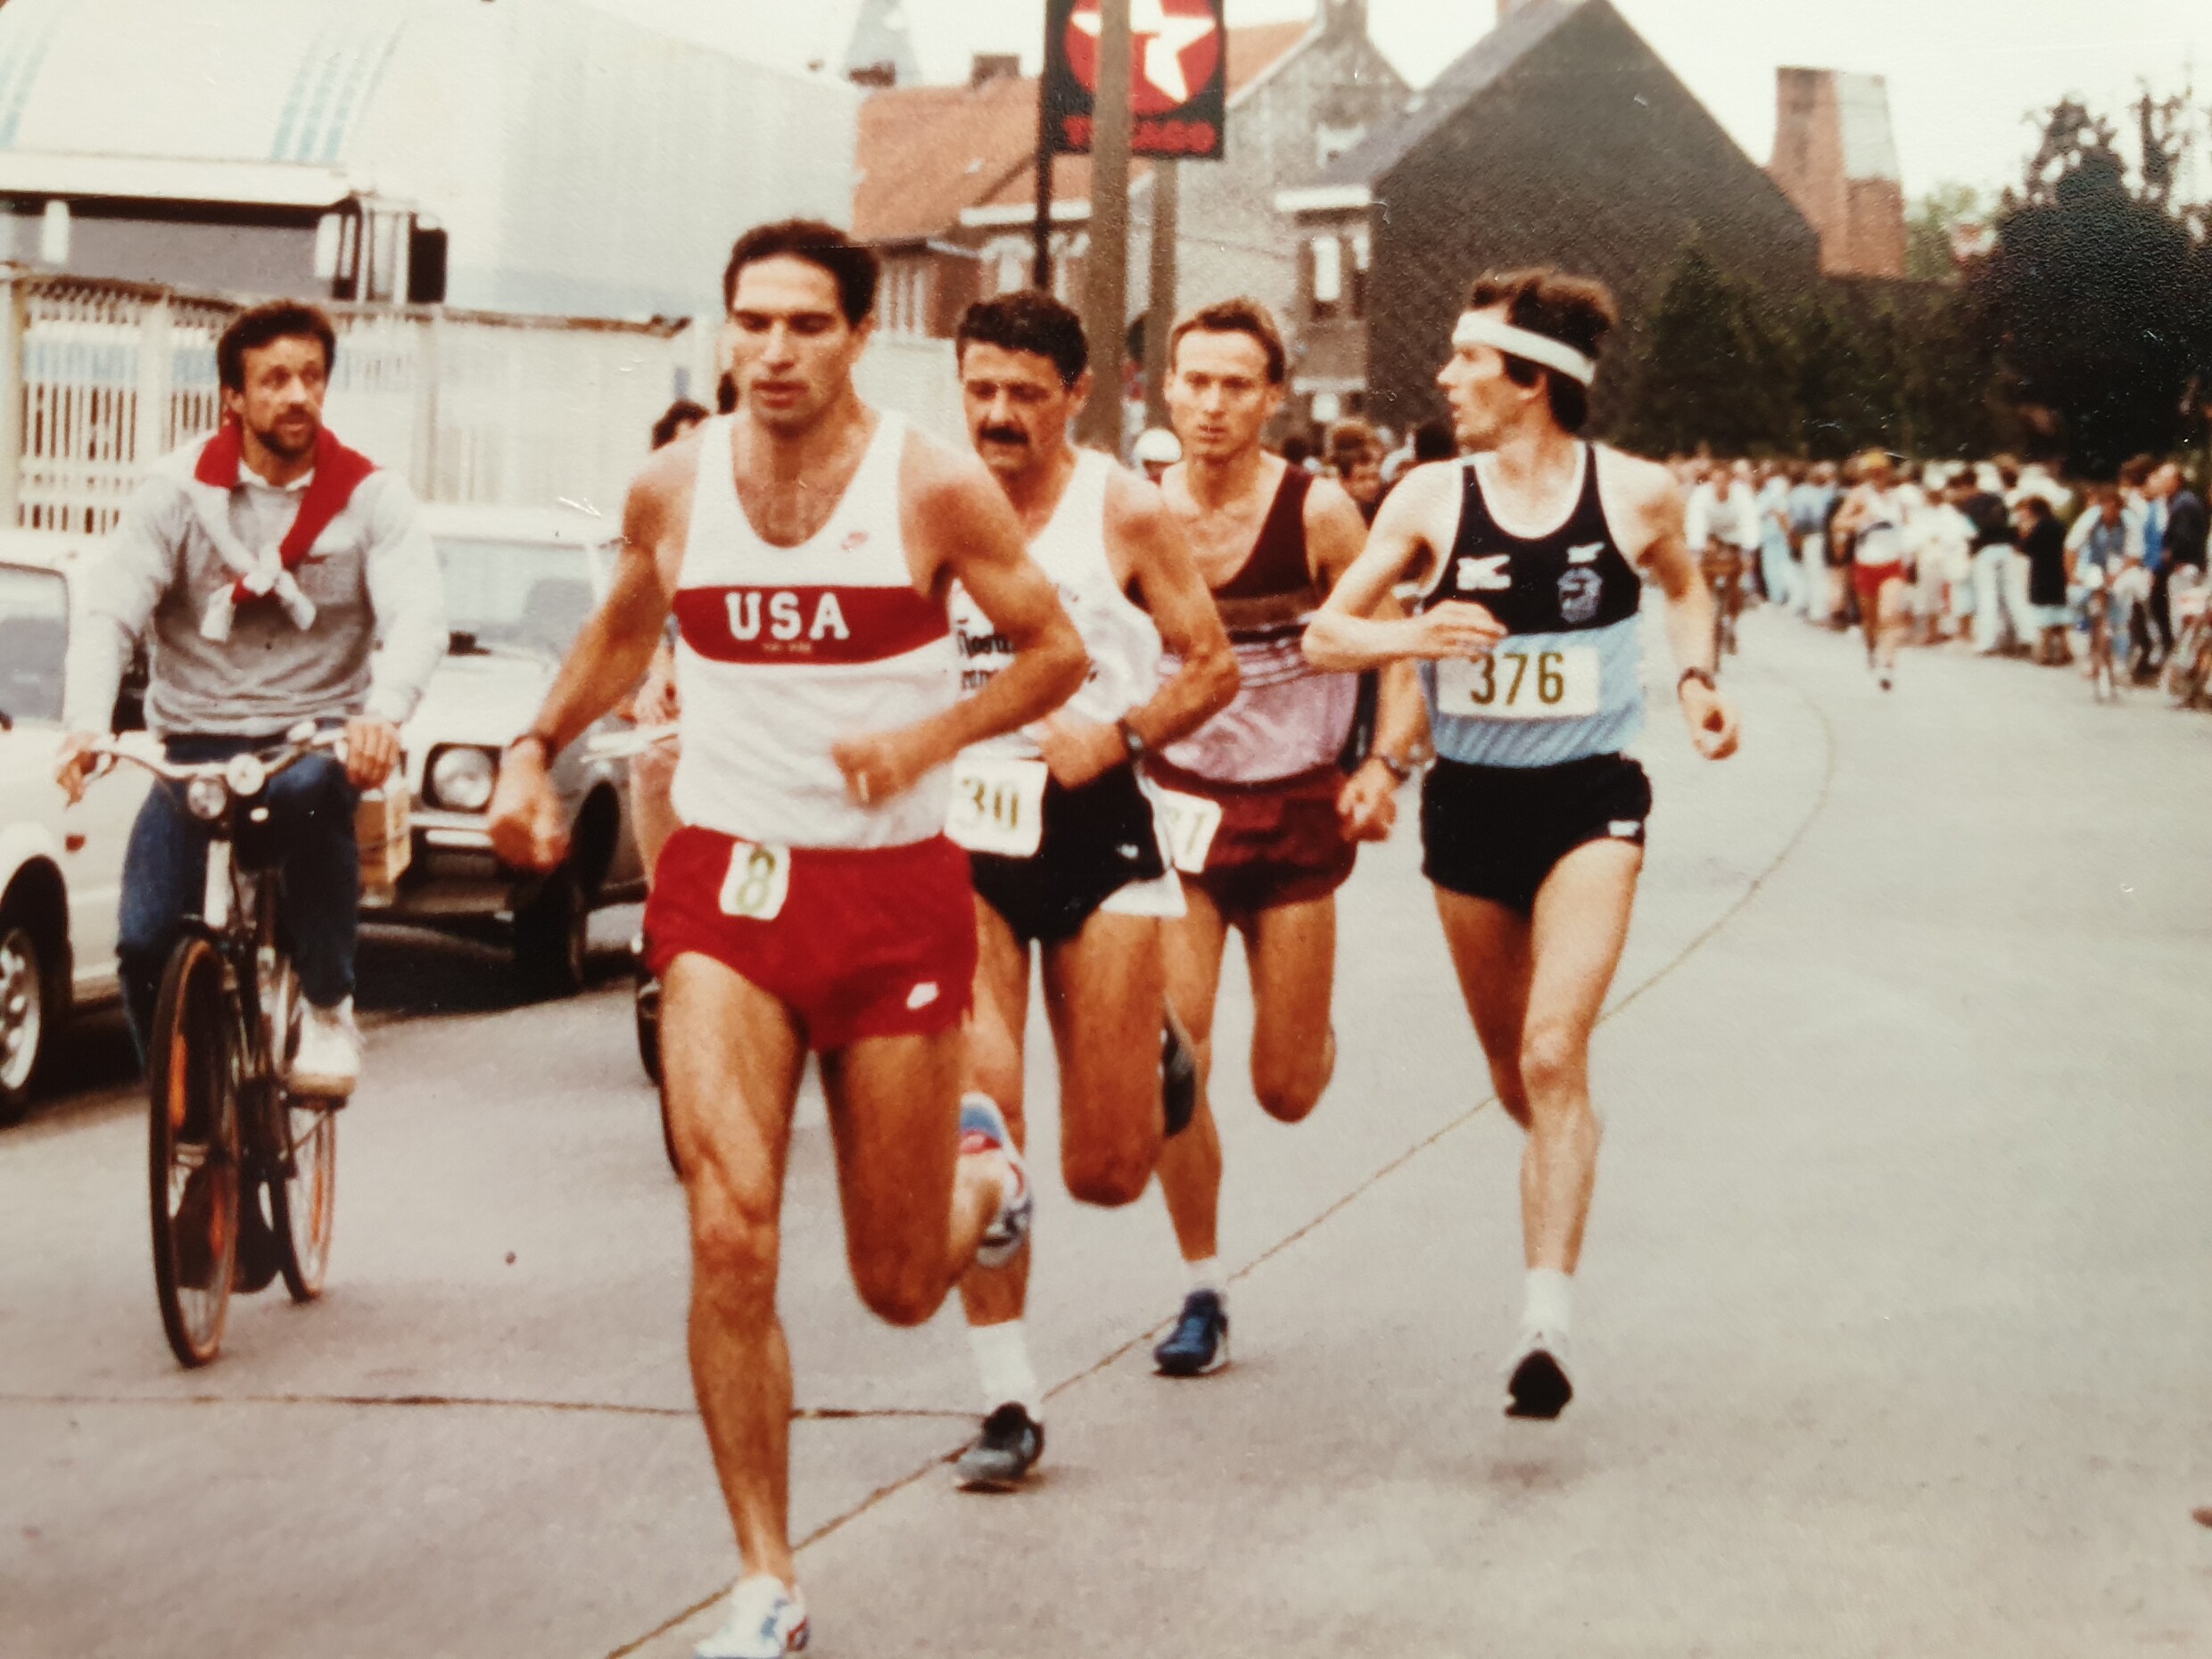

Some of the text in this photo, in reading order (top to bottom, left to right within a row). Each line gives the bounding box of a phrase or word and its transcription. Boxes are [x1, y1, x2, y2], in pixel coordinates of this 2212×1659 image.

[725, 592, 849, 640] USA
[1470, 651, 1565, 706] 376
[956, 776, 1020, 831] 30
[736, 848, 776, 913] 8
